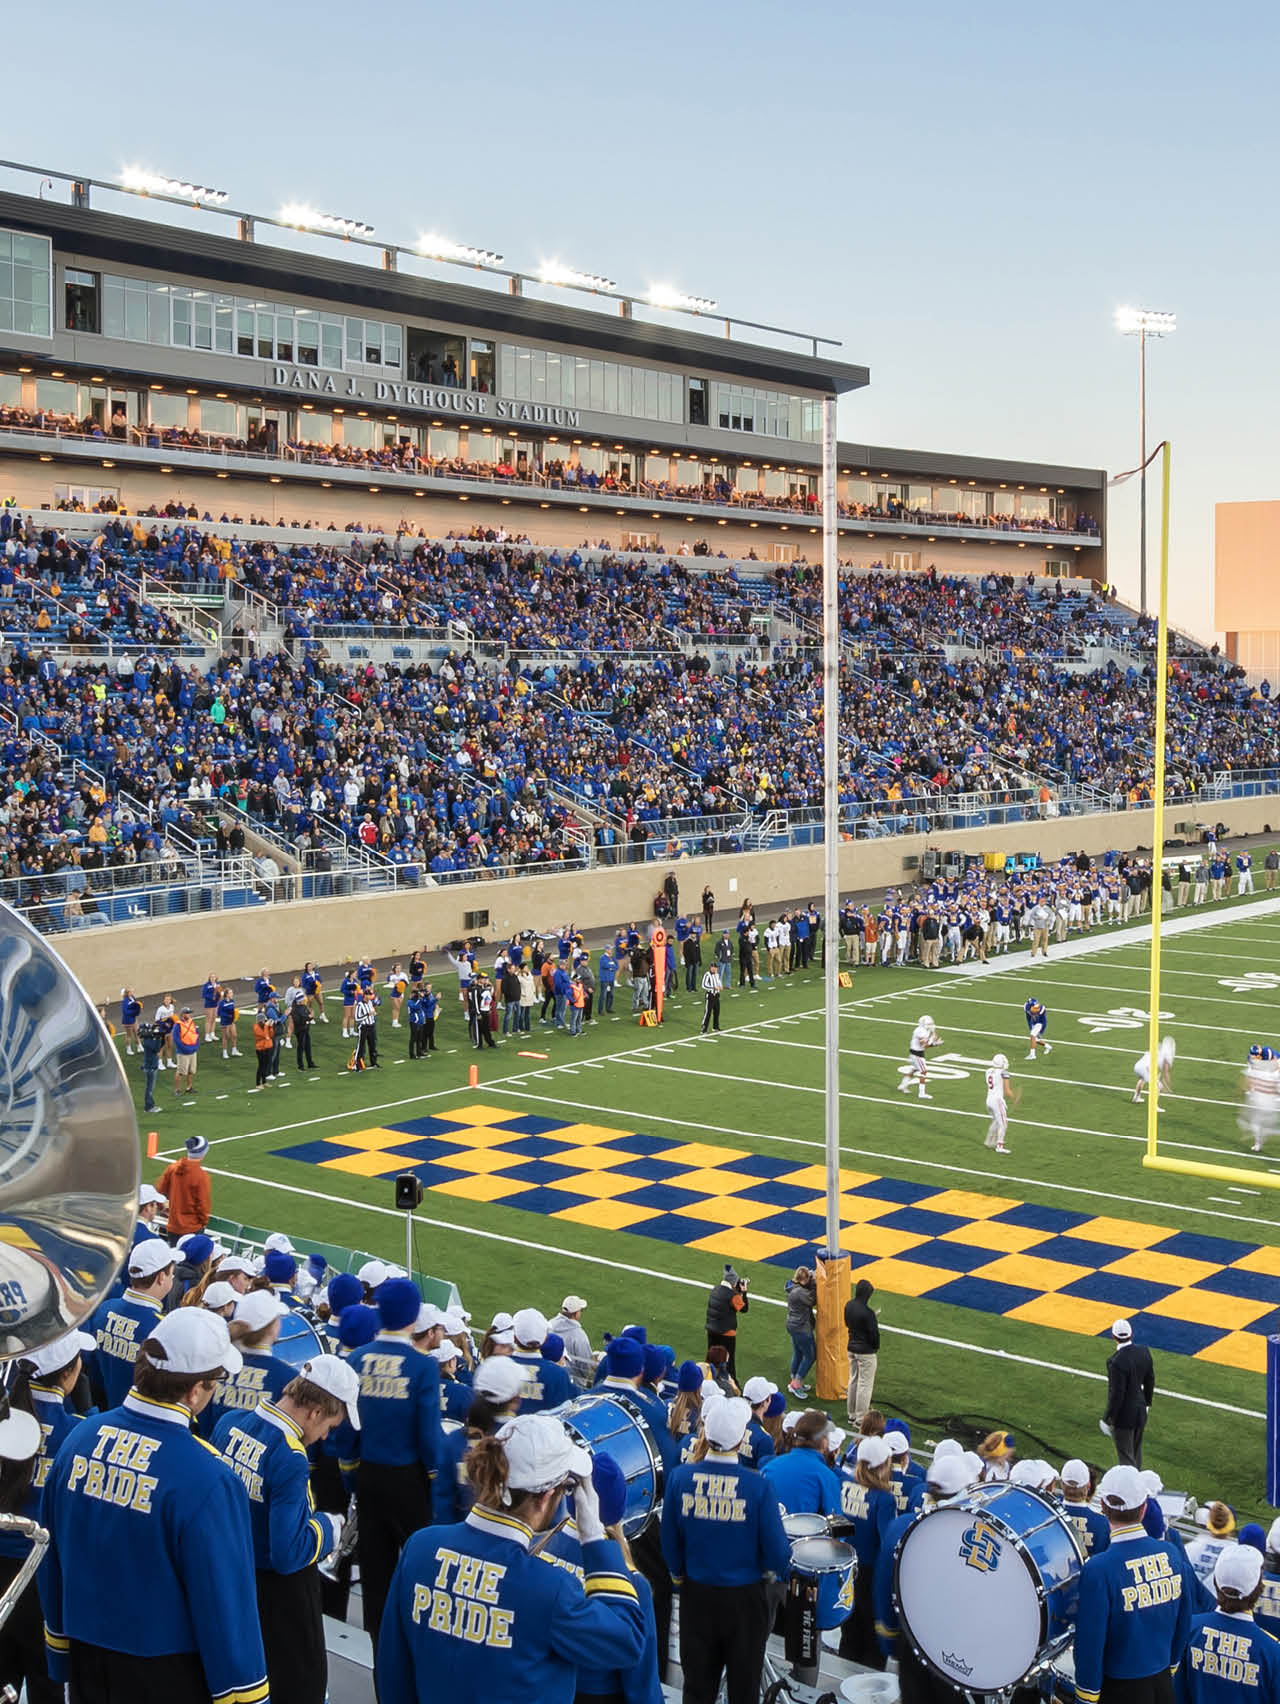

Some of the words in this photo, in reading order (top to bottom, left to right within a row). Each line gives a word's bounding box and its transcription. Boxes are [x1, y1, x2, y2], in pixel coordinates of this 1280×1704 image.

[273, 367, 337, 393] DANA
[346, 377, 365, 397] J.
[375, 381, 489, 414] DYKHOUSE
[496, 400, 581, 427] STADIUM
[987, 1075, 995, 1090] 9
[107, 1311, 140, 1341] THE
[96, 1329, 141, 1363] PRIDE
[362, 1353, 406, 1377] THE
[360, 1375, 411, 1399] RIDE
[92, 1425, 162, 1472] THE
[228, 1426, 268, 1472] THE
[67, 1454, 160, 1514] PRIDE
[692, 1472, 740, 1498] THE
[681, 1492, 747, 1522] PRIDE
[435, 1547, 508, 1605] THE
[1125, 1552, 1174, 1584] THE
[1121, 1574, 1182, 1612] PRIDE
[412, 1583, 516, 1649] PRIDE
[1202, 1626, 1253, 1661] THE
[1190, 1646, 1261, 1687] PRIDE
